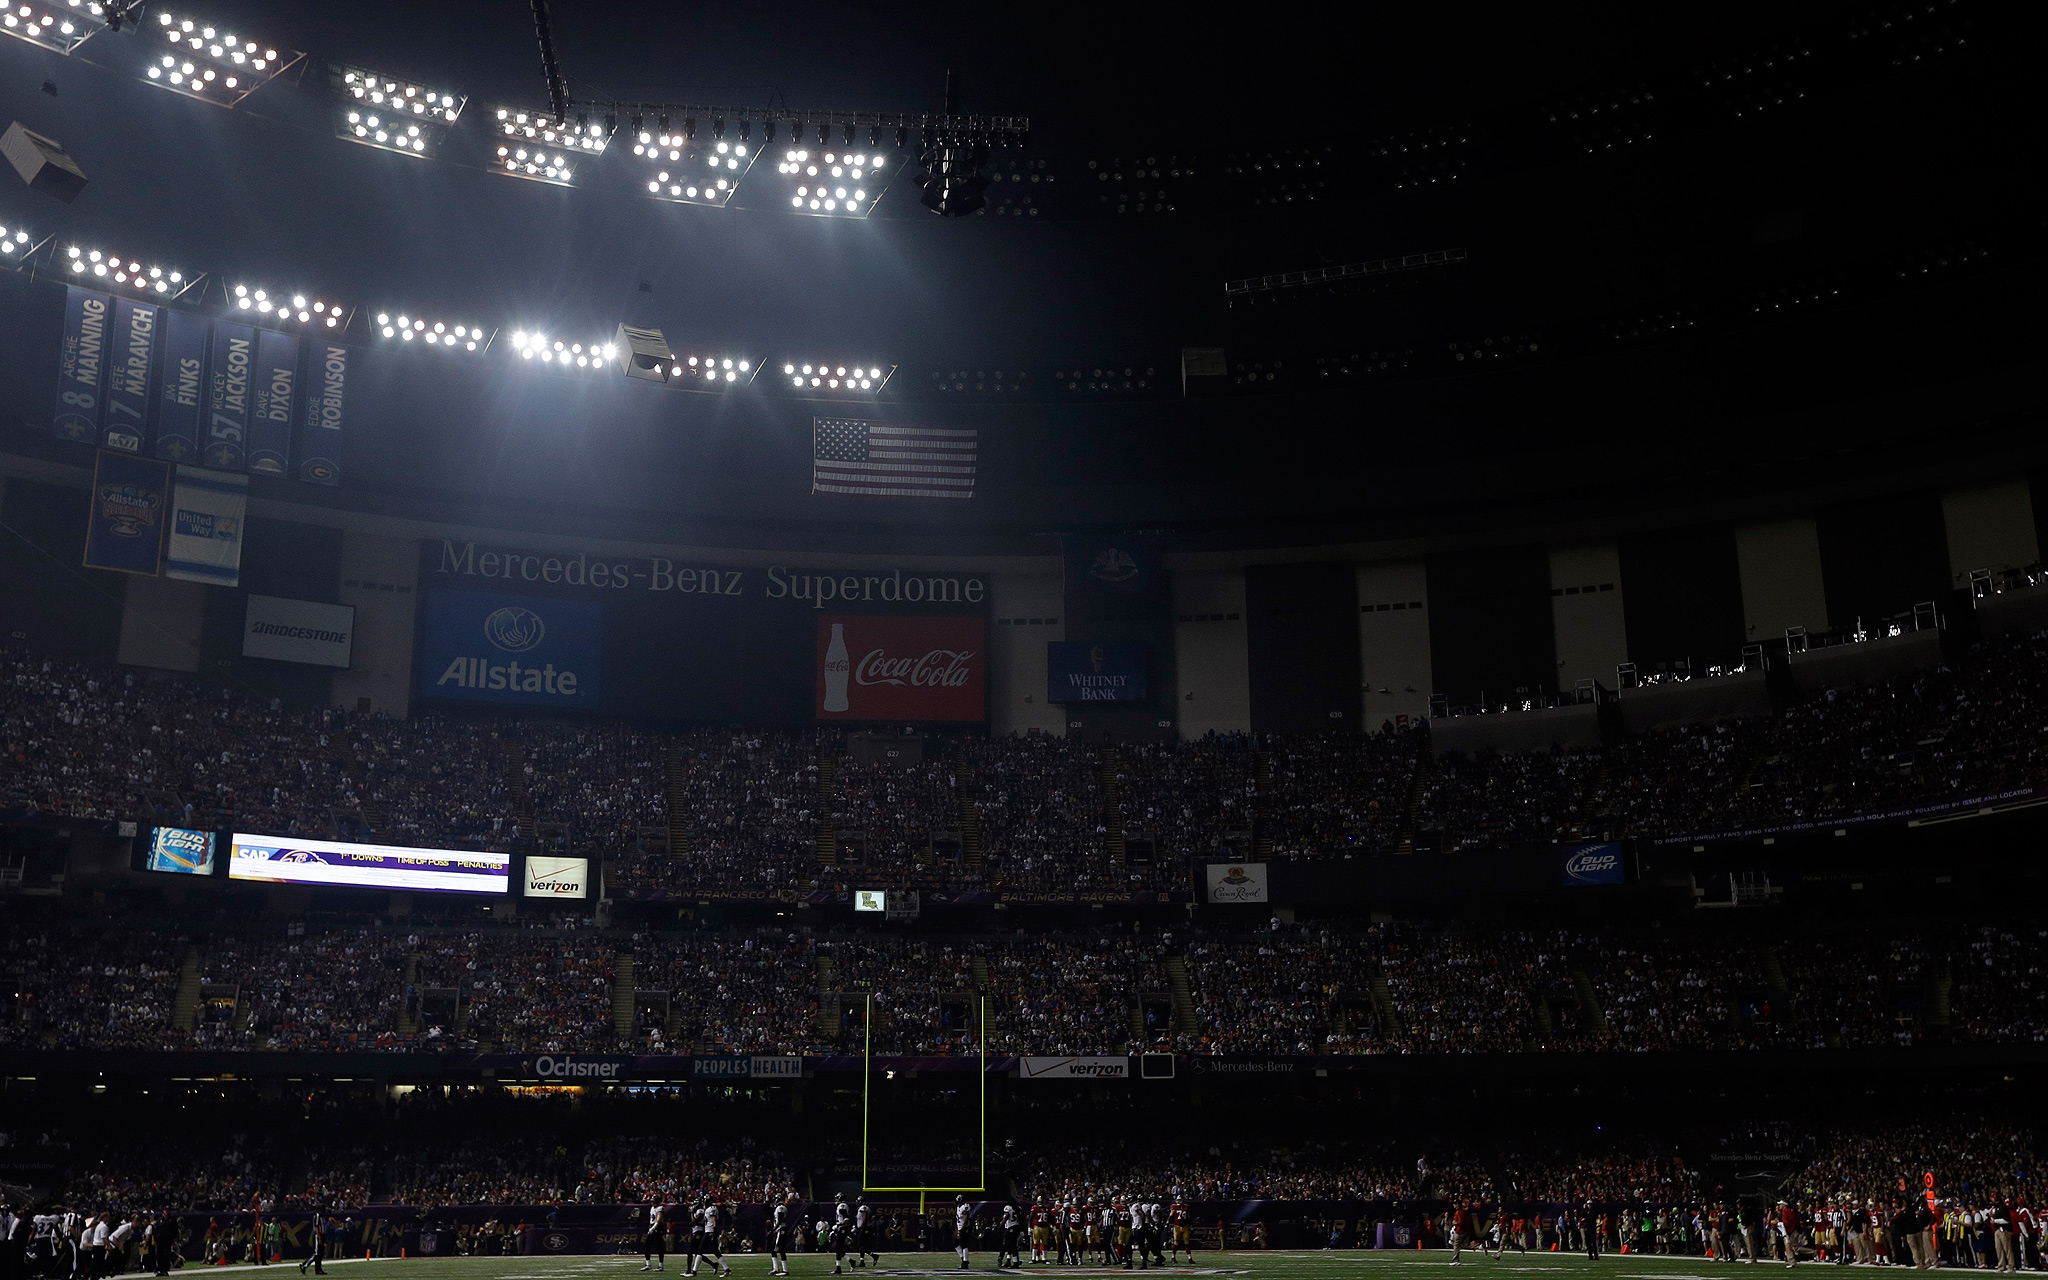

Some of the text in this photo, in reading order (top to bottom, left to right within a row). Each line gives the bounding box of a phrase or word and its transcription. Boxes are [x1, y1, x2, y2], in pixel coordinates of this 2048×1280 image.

[77, 299, 105, 386] MANNING
[63, 335, 78, 378] ARCHIE
[125, 308, 153, 397] MARAVICH
[111, 365, 125, 391] PETE
[177, 358, 200, 406] FINKS
[225, 338, 249, 415] JACKSON
[211, 371, 225, 410] RICKEY
[269, 368, 293, 422] DIXON
[321, 347, 346, 430] ROBINSON
[62, 391, 95, 409] 8
[255, 390, 269, 418] DAVE
[110, 400, 142, 419] 7
[307, 397, 320, 427] EDDIE
[210, 412, 242, 442] 57
[106, 492, 149, 509] Allstate
[179, 511, 212, 526] United
[191, 523, 212, 538] Way
[436, 539, 984, 609] Mercedes-Benz Superdome
[251, 621, 348, 643] BRIDGESTONE
[855, 648, 977, 687] Coca-Cola
[436, 656, 578, 696] Allstate
[1068, 673, 1127, 687] WHITNEY
[1080, 687, 1117, 700] BANK
[1158, 720, 1171, 728] 629
[887, 750, 900, 758] 627
[1665, 836, 1692, 844] REPORT
[1694, 833, 1721, 841] UNRULY
[1834, 816, 1865, 825] KEYWORD
[1866, 812, 1886, 821] NOLA
[1915, 803, 1950, 814] FOLLOWED
[1951, 800, 1961, 808] BY
[1962, 796, 1982, 806] ISSUE
[1984, 794, 1998, 802] AND
[1999, 787, 2034, 800] LOCATION
[168, 829, 205, 845] BUD
[162, 838, 206, 853] LIGHT
[238, 848, 270, 860] SAP
[351, 853, 385, 863] DOWNS
[1580, 855, 1616, 865] BUD
[397, 857, 415, 865] TIME
[428, 859, 450, 867] POSS
[457, 861, 503, 870] PENALTIES
[1573, 861, 1618, 872] LIGHT
[530, 879, 580, 894] verizon
[1213, 887, 1236, 900] Crown
[667, 890, 694, 898] SAN
[697, 891, 767, 900] FRANCISCO
[1001, 892, 1132, 902] BALTIMORE RAVENS
[535, 1055, 620, 1077] Ochsner
[694, 1059, 800, 1075] PEOPLES HEALTH
[1069, 1062, 1124, 1077] verizon
[1211, 1060, 1295, 1073] Mercedes-Benz
[834, 1164, 981, 1173] NATIONAL FOOTBALL LEAGUE
[876, 1207, 957, 1216] SUPER BOW
[1037, 1212, 1048, 1222] 76
[1086, 1212, 1097, 1222] 84
[1119, 1211, 1130, 1221] 77
[1176, 1210, 1187, 1220] 74
